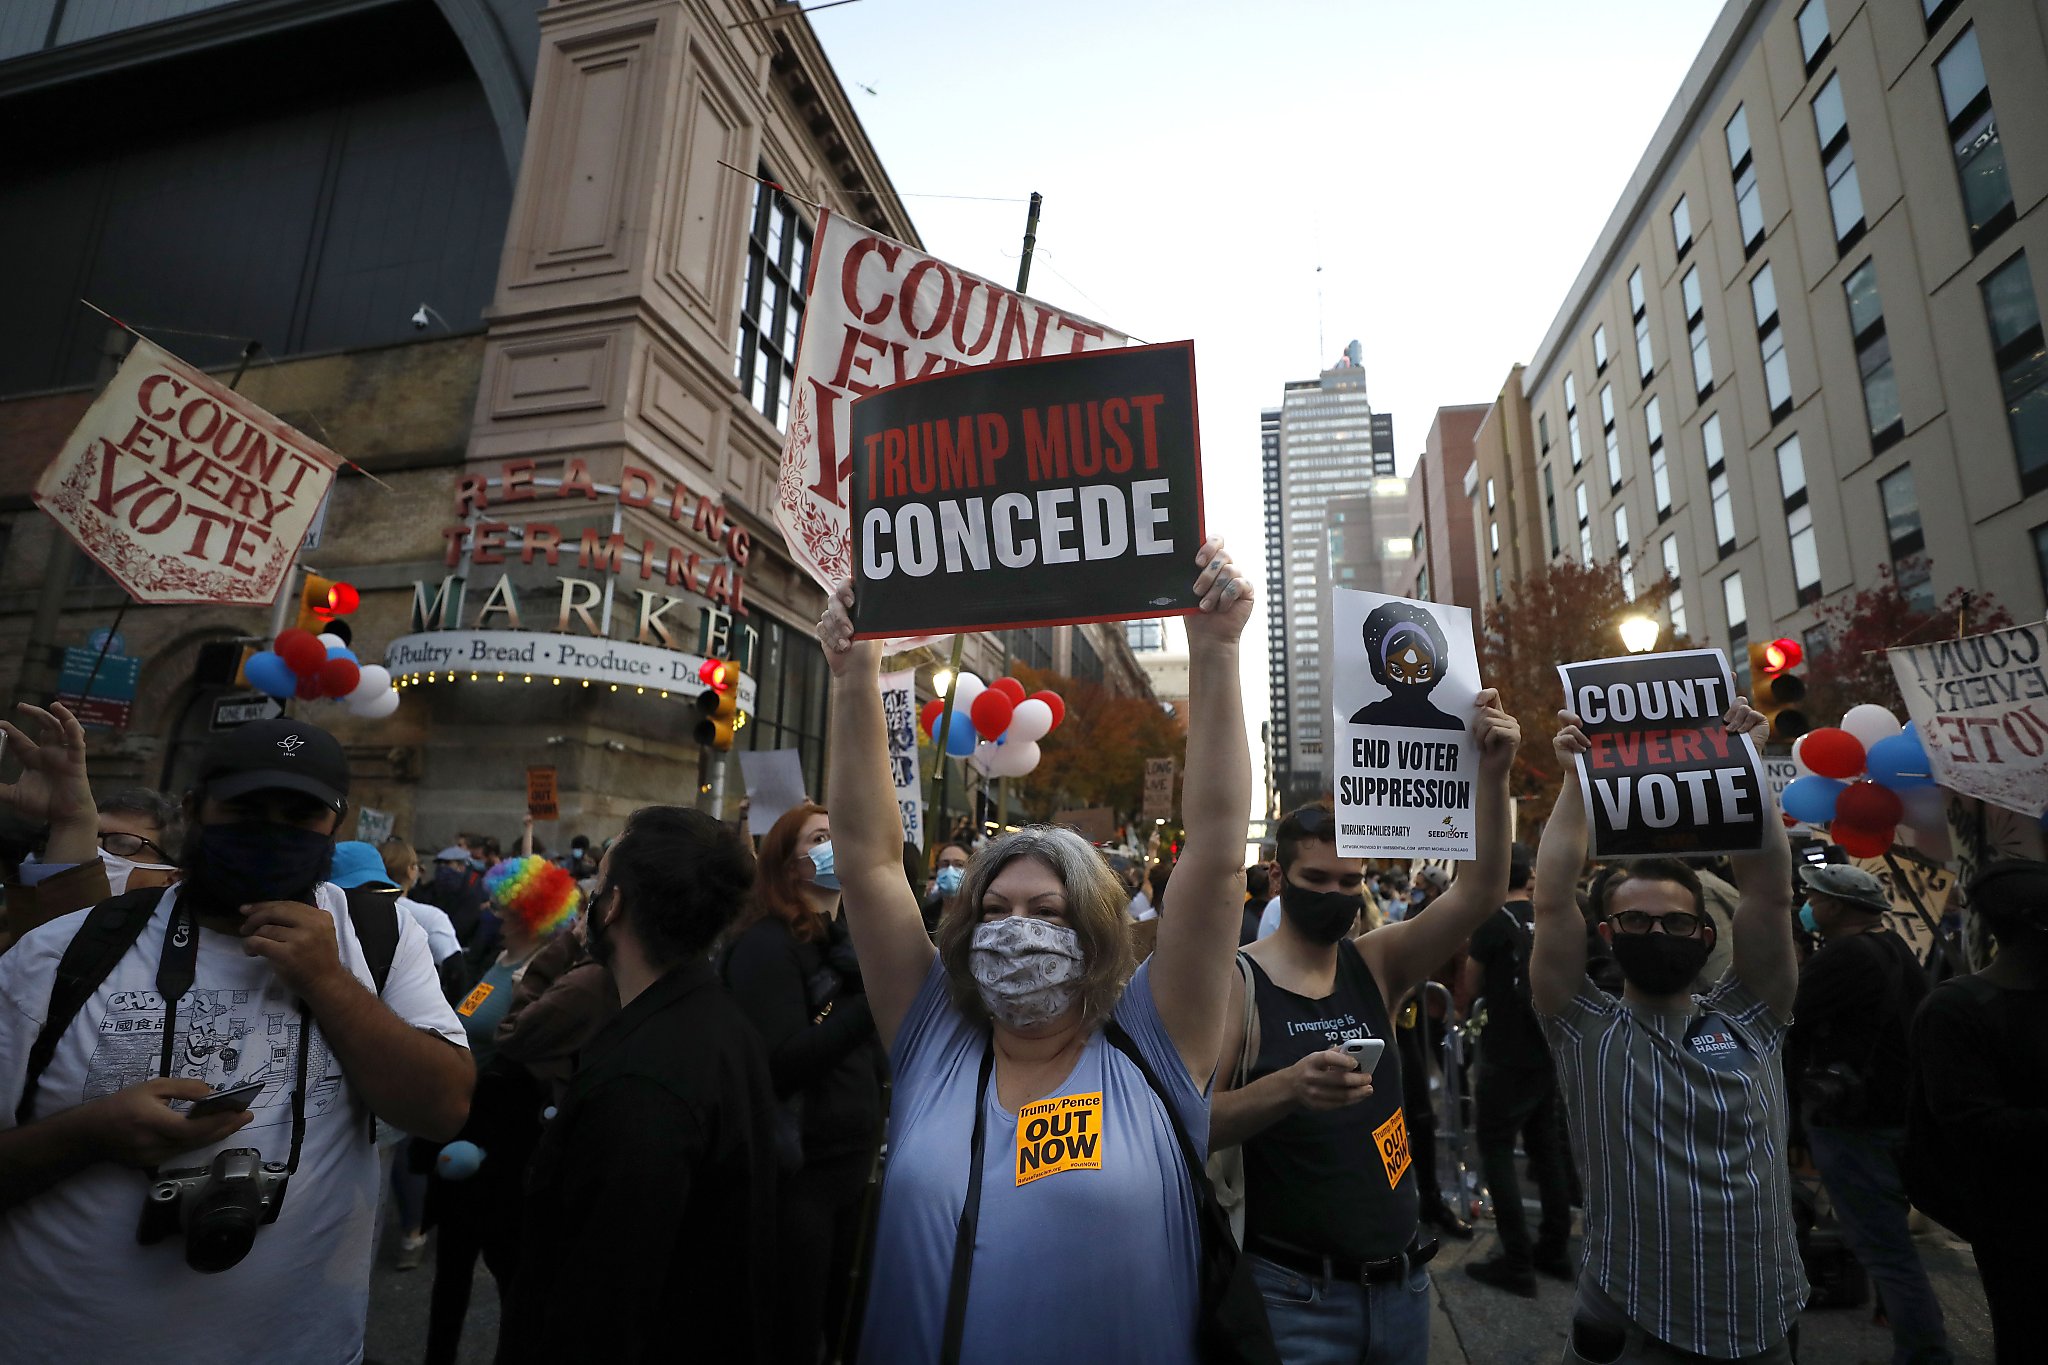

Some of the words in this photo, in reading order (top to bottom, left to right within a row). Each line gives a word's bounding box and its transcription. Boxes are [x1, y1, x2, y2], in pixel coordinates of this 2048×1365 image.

[137, 374, 319, 498] COUNT
[864, 413, 1009, 500] TRUMP
[1022, 394, 1164, 482] MUST
[117, 416, 294, 528] EVERY
[89, 437, 273, 576] VOTE
[455, 459, 750, 568] READING
[862, 478, 1175, 580] CONCEDE
[443, 522, 750, 617] TERMINAL
[411, 572, 760, 676] MARKET
[400, 642, 452, 665] Poultry
[470, 639, 535, 662] Bread
[557, 643, 650, 674] Produce
[218, 706, 240, 722] ONE
[243, 704, 266, 720] WAY
[1578, 677, 1721, 724] COUNT
[1352, 738, 1390, 768] END
[1398, 741, 1459, 771] VOTER
[1592, 726, 1730, 769] EVERY
[1768, 763, 1797, 777] NO
[1340, 775, 1470, 809] SUPPRESSION
[1595, 767, 1754, 831] VOTE
[1341, 824, 1365, 836] WORKING
[1366, 825, 1391, 837] FAMILIES
[1391, 825, 1410, 838] PARTY
[1324, 1031, 1339, 1041] so
[1343, 1013, 1356, 1026] is
[1690, 1032, 1734, 1046] BIDEN
[1695, 1041, 1738, 1054] HARRIS
[1021, 1097, 1100, 1118] Trump/Pence
[1026, 1110, 1093, 1143] OUT
[1019, 1133, 1099, 1175] NOW
[1384, 1123, 1404, 1158] OUT
[1386, 1138, 1408, 1180] NOW
